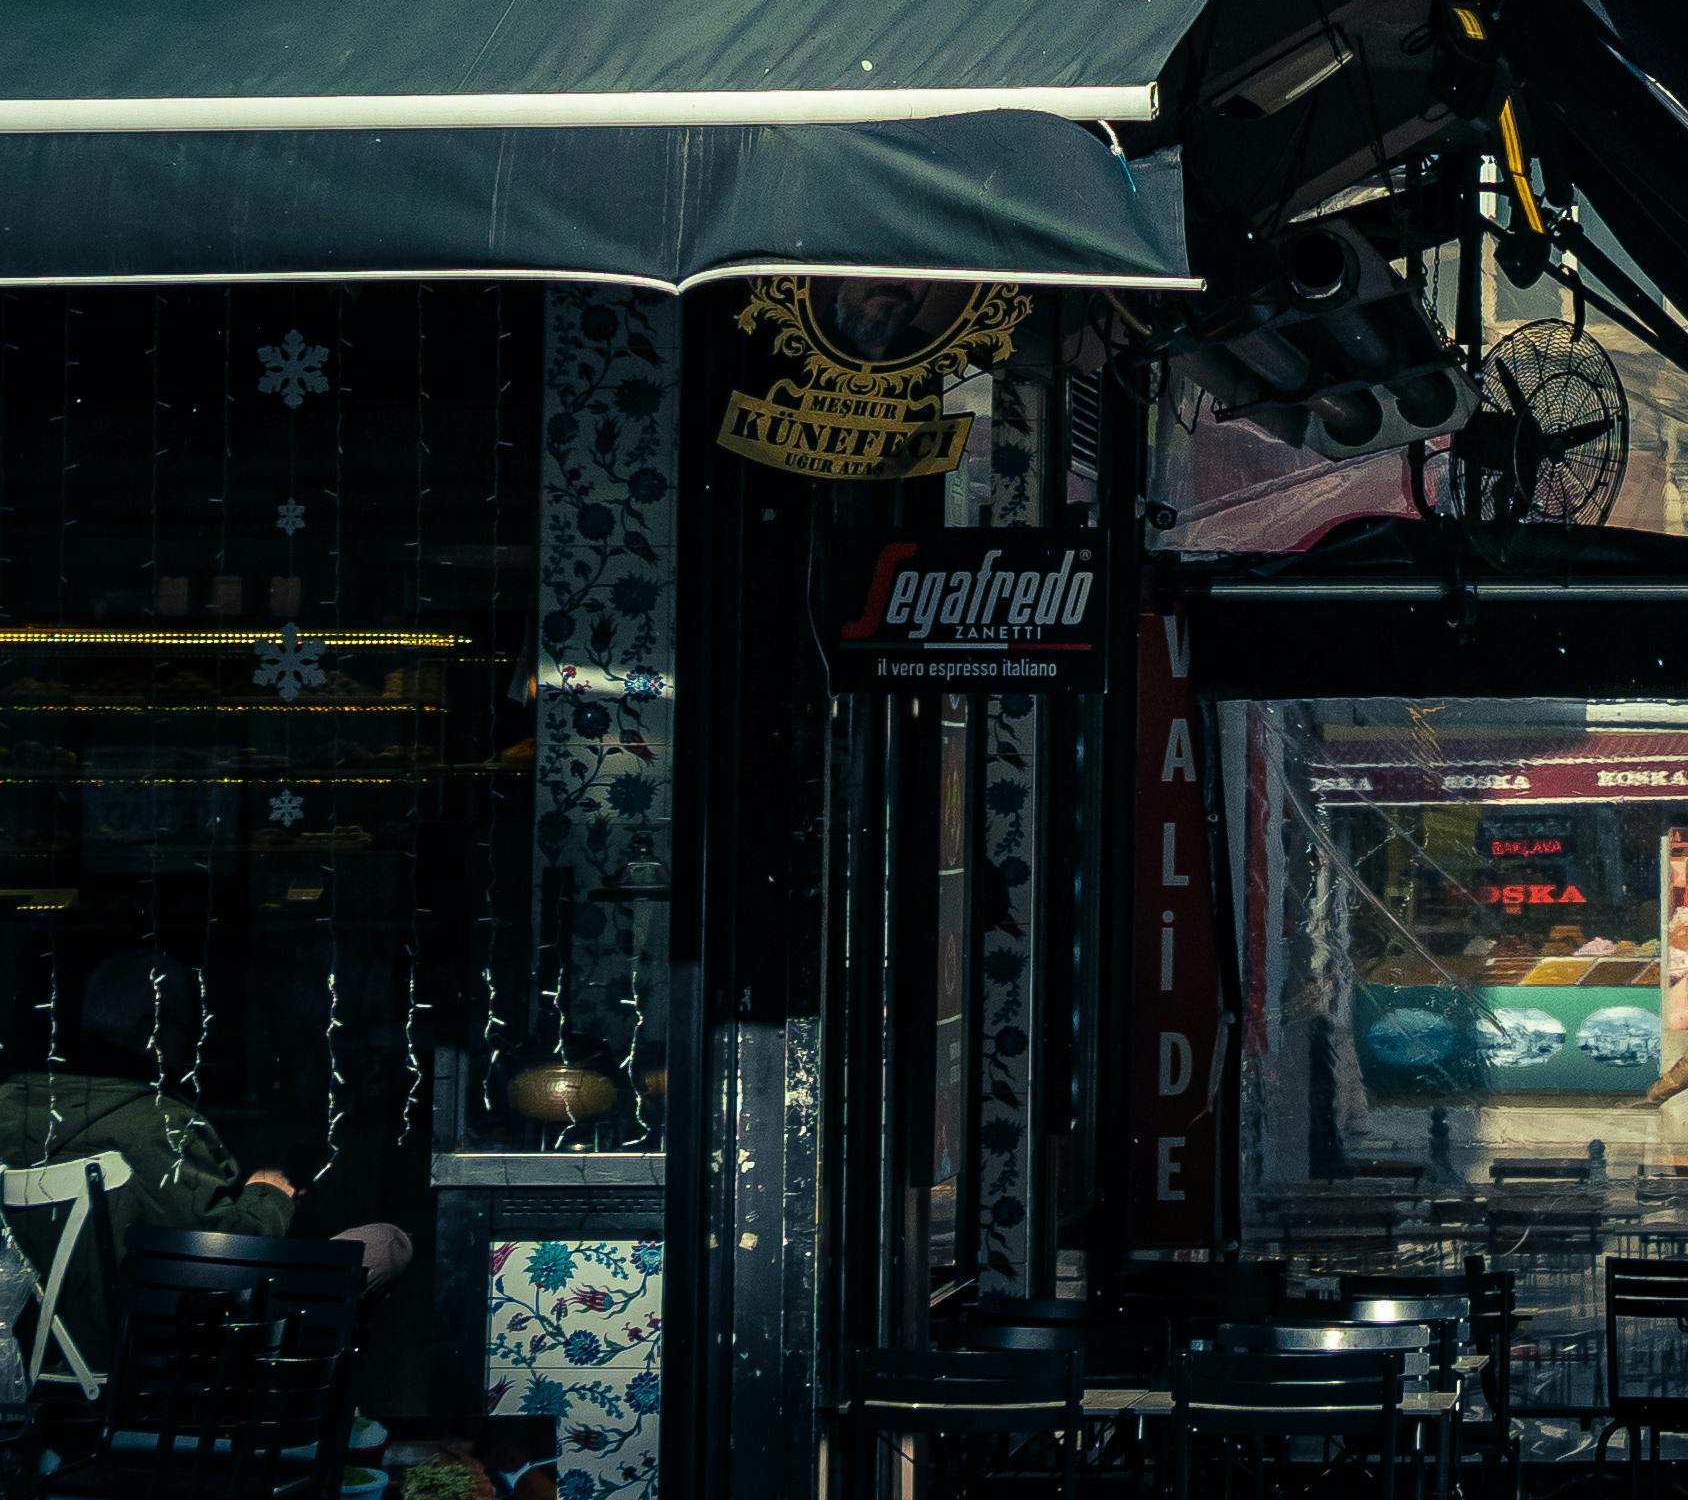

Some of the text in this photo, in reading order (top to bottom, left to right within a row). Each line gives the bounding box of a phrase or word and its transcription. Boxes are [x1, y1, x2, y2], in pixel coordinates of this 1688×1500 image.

[809, 393, 898, 421] MEŞHUR
[729, 406, 958, 460] KÜNEFECİ
[839, 541, 1095, 640] Segafredo
[954, 625, 1042, 640] ZANETTI
[877, 657, 1058, 682] il vero espresso italiano
